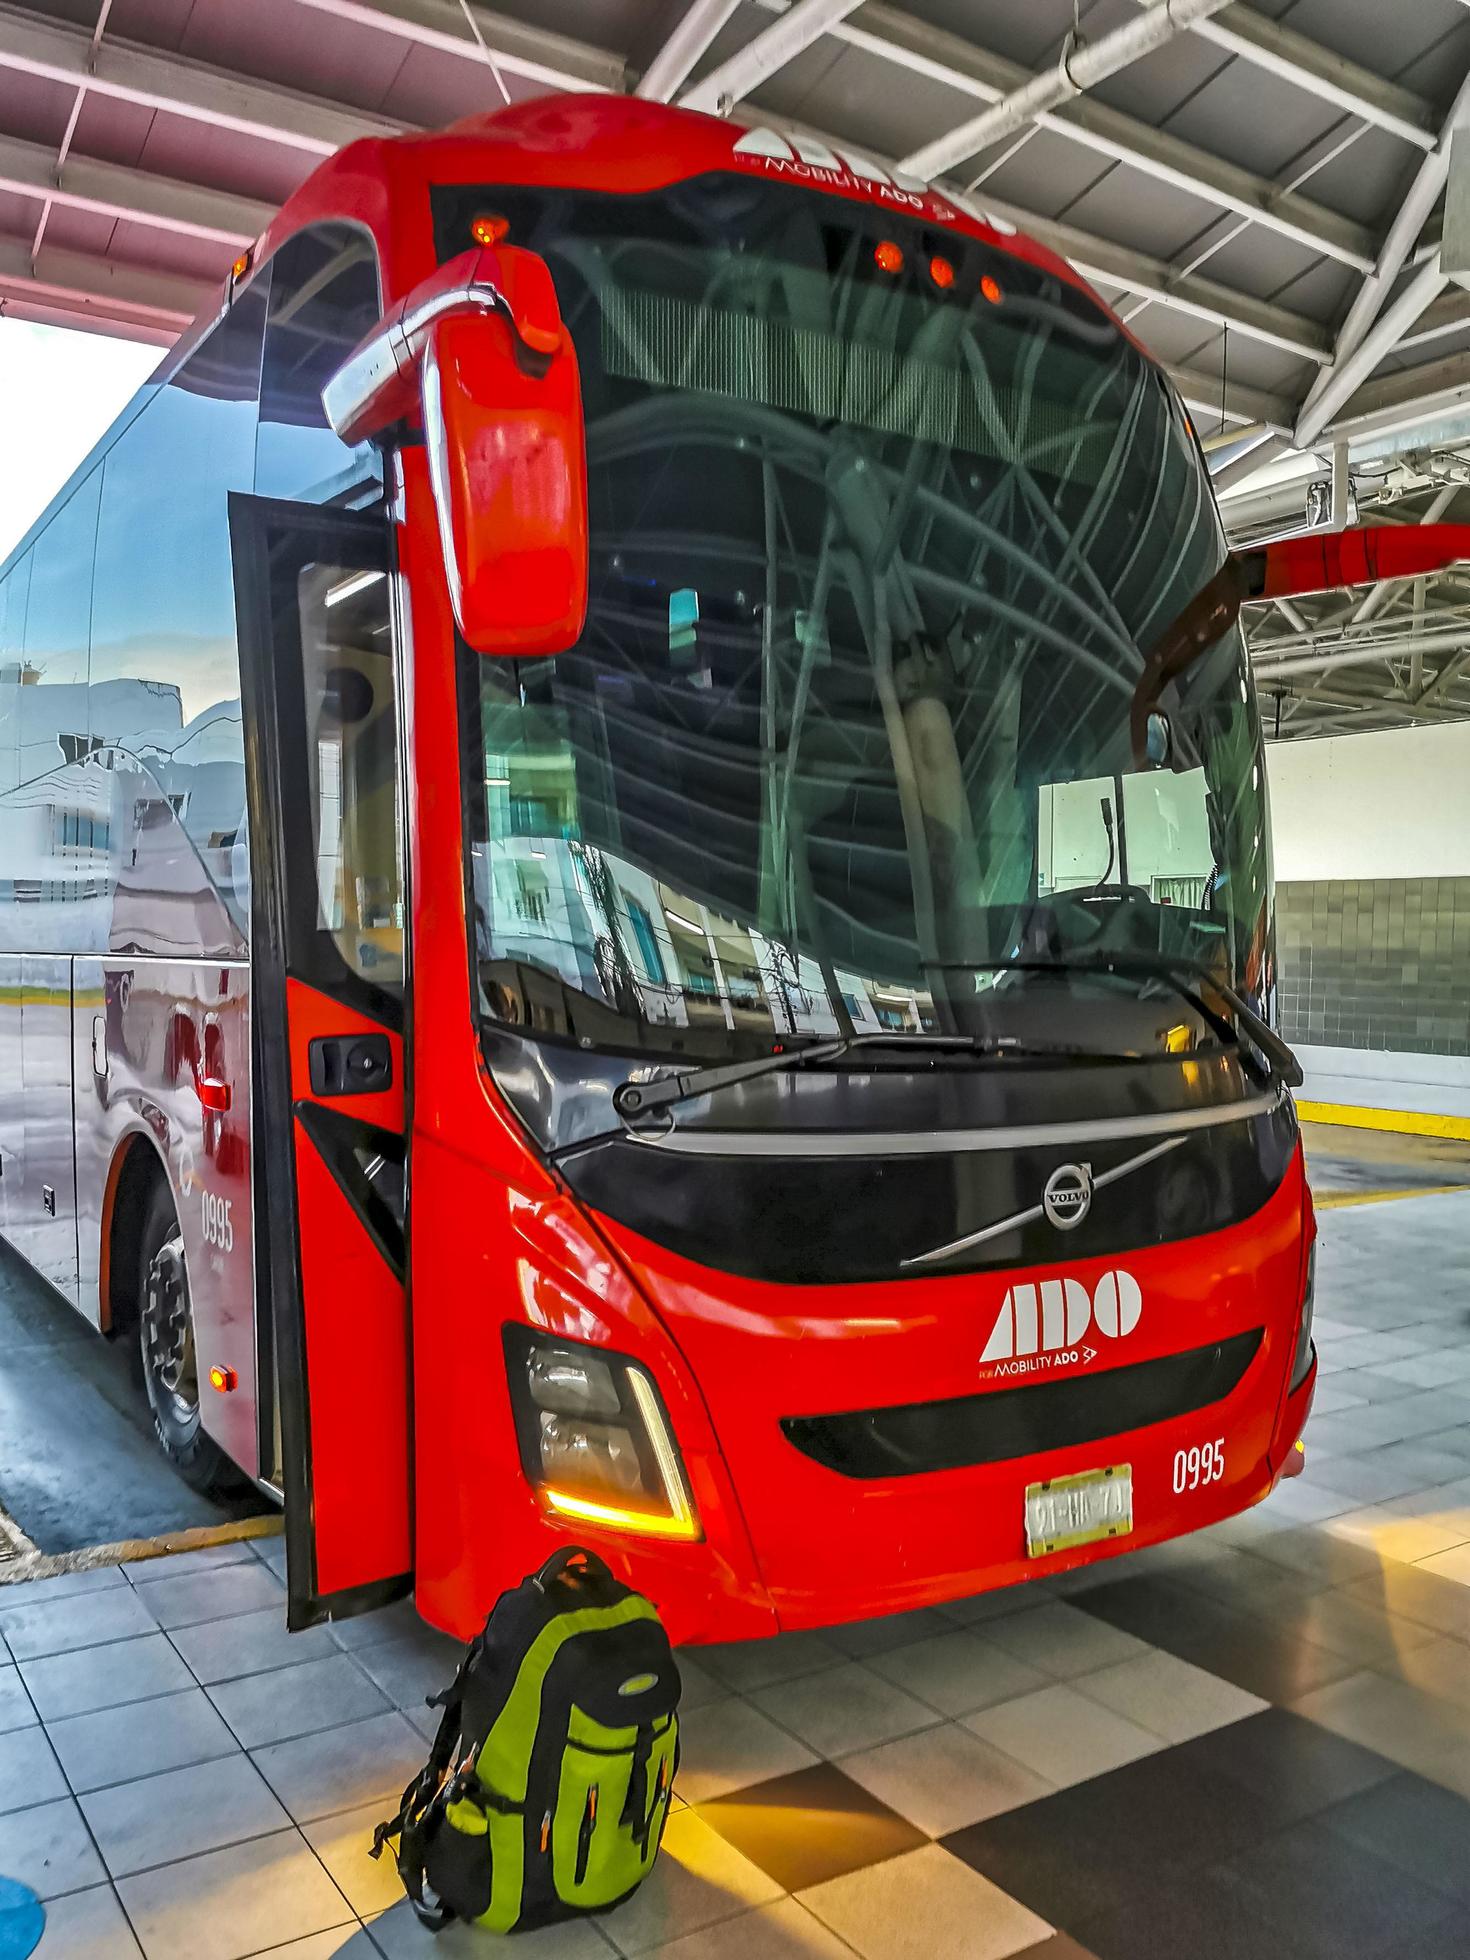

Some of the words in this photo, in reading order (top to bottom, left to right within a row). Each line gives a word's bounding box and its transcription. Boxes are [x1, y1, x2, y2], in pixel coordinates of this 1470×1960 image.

[880, 186, 924, 209] ADO
[1047, 1190, 1089, 1203] VOLVO
[201, 1190, 233, 1253] 0995
[979, 1270, 1142, 1363] ADO
[994, 1355, 1052, 1378] MOBILITY
[1053, 1350, 1079, 1367] ADO
[1172, 1437, 1225, 1494] 0995
